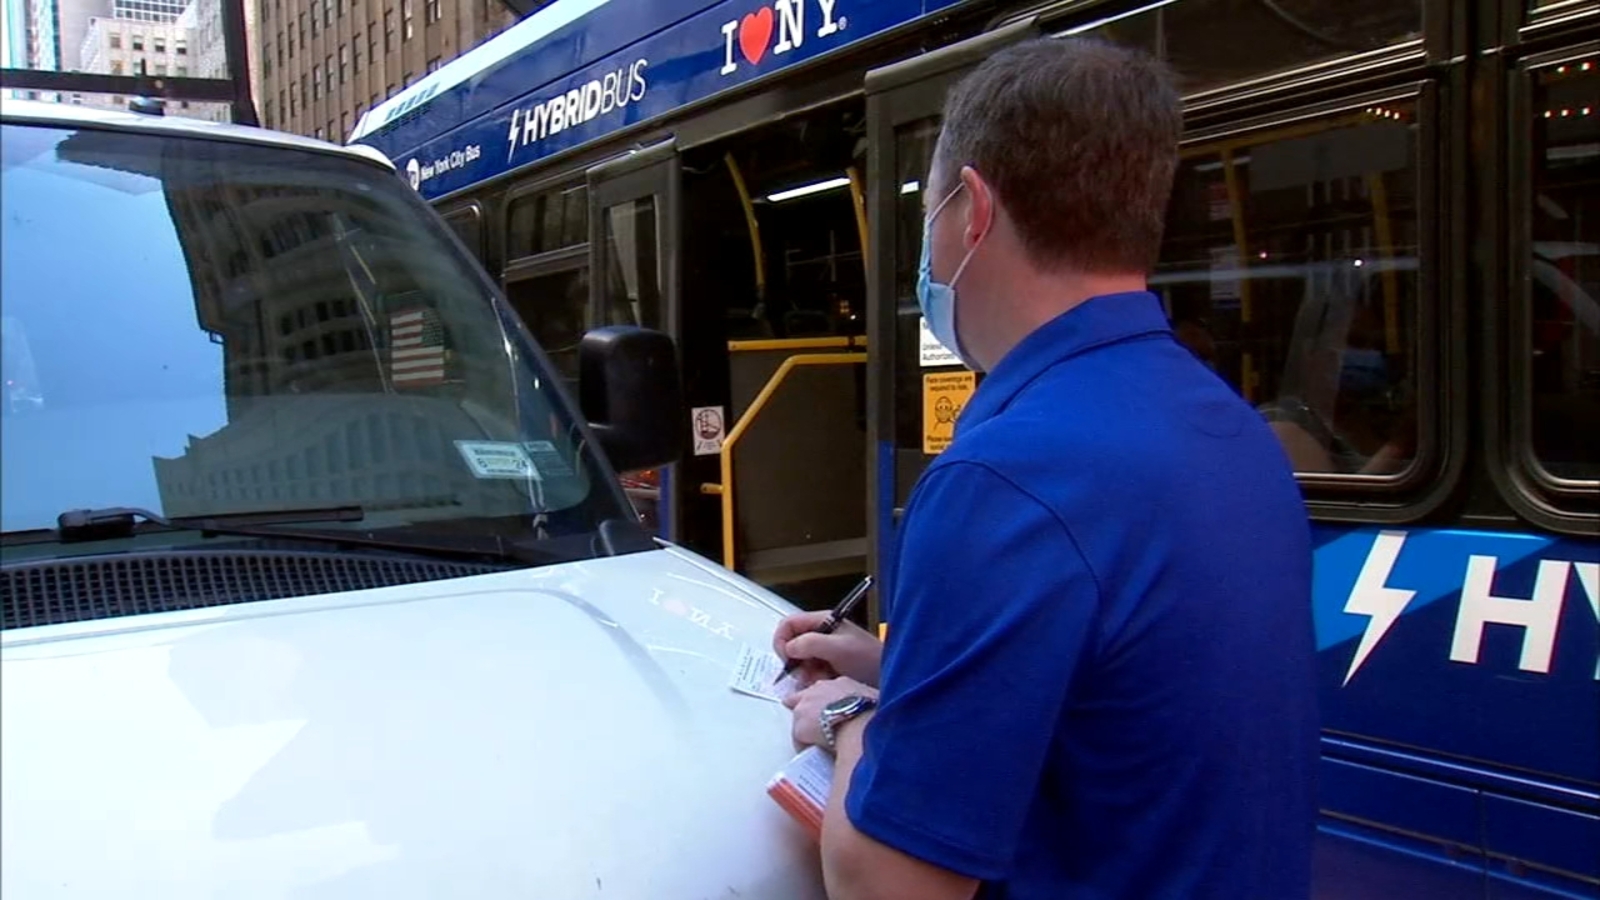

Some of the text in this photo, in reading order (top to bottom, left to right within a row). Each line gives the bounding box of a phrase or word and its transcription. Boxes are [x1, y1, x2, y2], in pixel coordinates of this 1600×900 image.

[720, 19, 738, 76] I
[420, 165, 434, 181] New
[434, 155, 450, 175] York
[450, 149, 465, 168] City
[465, 144, 481, 162] Bus
